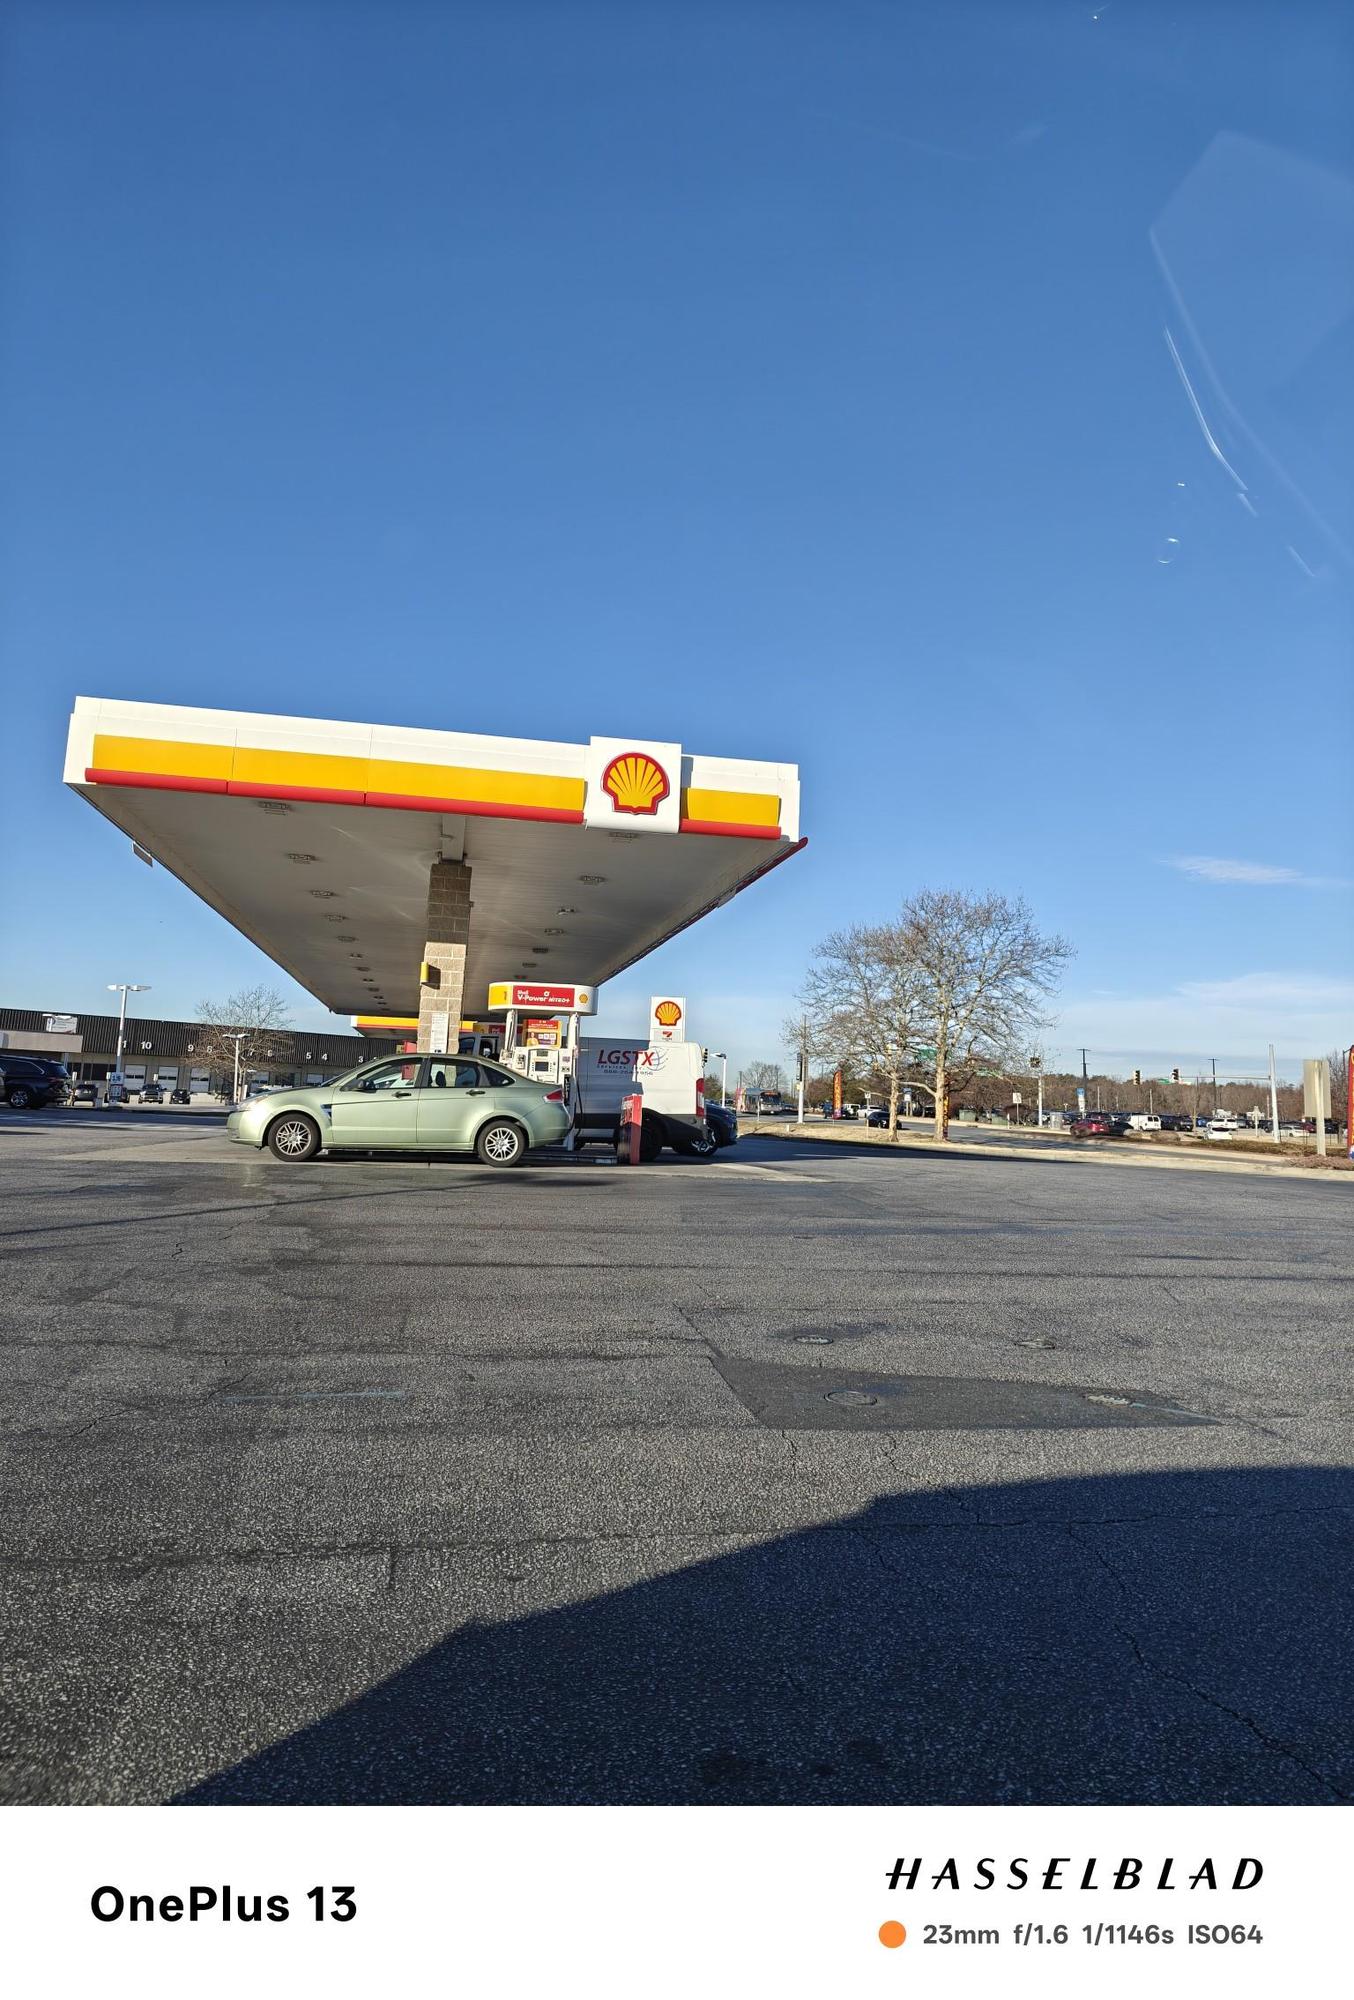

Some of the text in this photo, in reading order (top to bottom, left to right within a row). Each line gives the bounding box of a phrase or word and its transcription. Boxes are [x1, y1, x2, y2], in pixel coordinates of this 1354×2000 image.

[517, 993, 548, 1002] V-Power
[140, 1041, 152, 1050] 10
[187, 1044, 194, 1052] 9
[305, 1052, 312, 1060] 5
[321, 1053, 328, 1061] 4
[358, 1055, 364, 1063] 3
[597, 1049, 655, 1066] LGSTX
